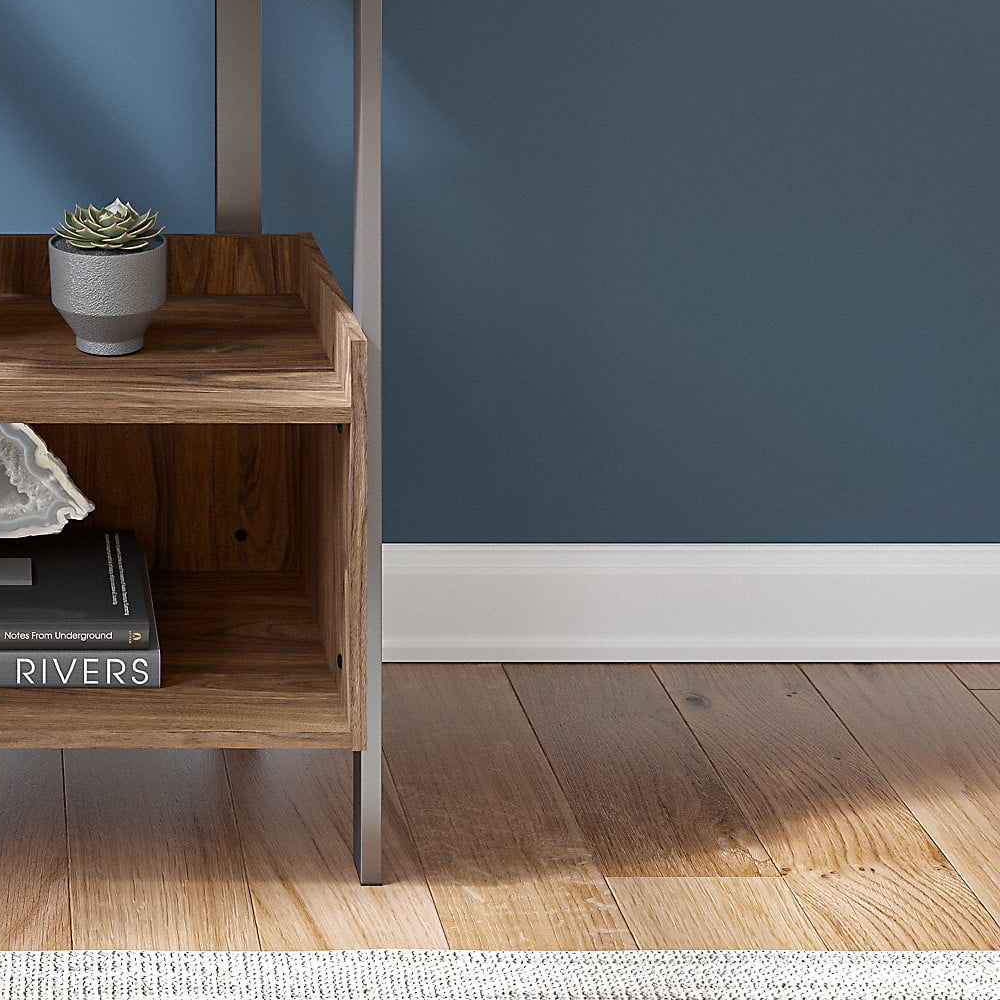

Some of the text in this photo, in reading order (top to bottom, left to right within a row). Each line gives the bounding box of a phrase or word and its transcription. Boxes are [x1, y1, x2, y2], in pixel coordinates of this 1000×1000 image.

[4, 631, 113, 642] Notes From Underground
[16, 658, 149, 685] RIVERS
